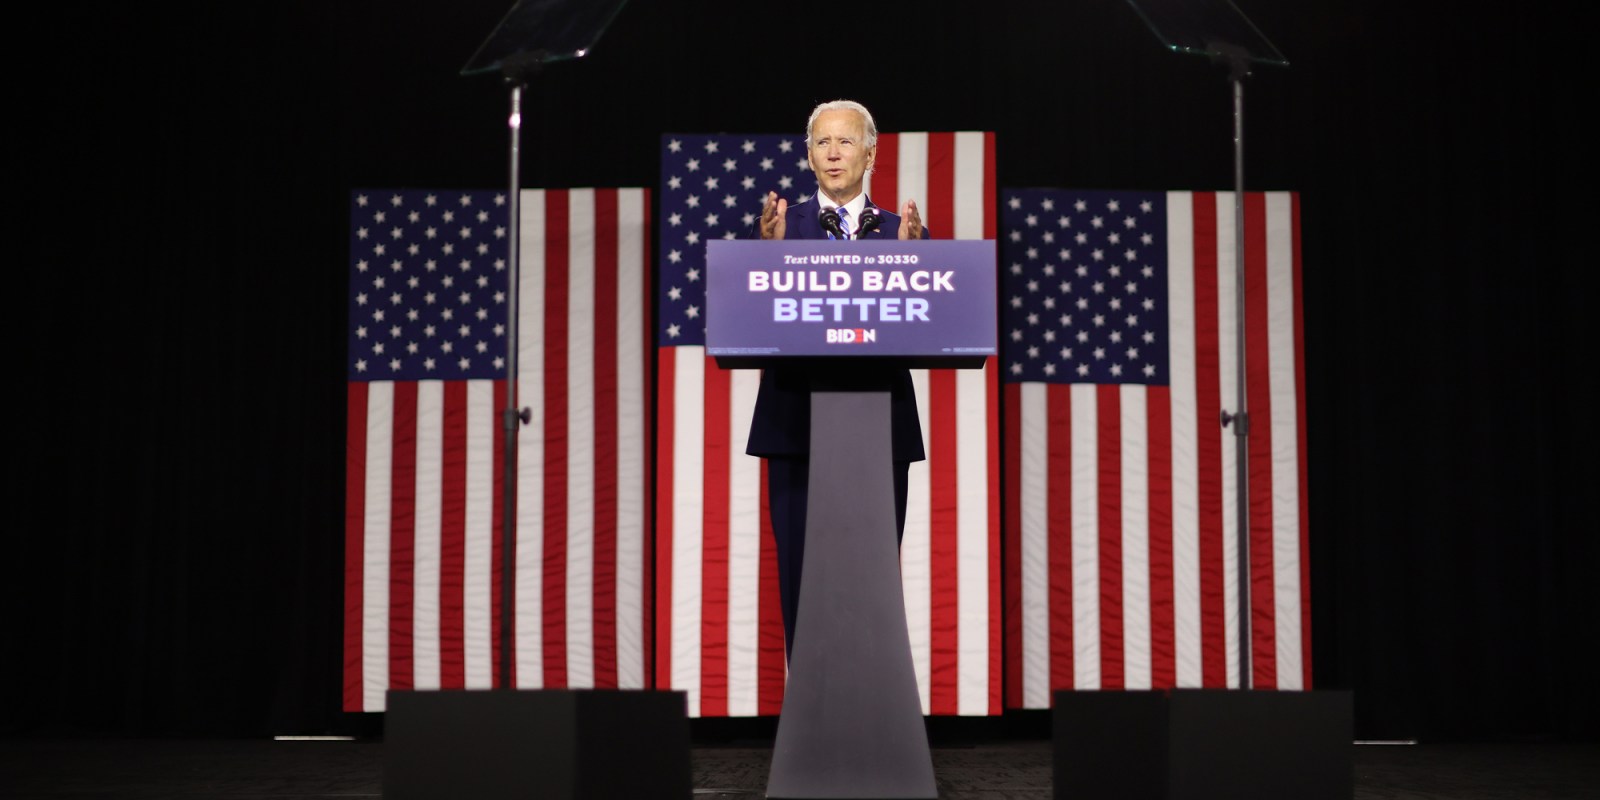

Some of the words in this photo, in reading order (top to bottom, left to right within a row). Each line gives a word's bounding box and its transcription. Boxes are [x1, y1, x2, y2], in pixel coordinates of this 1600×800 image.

[784, 255, 808, 265] Text
[811, 255, 861, 264] UNITED
[864, 256, 875, 265] to
[877, 255, 919, 264] 30330
[748, 270, 851, 292] BUILD
[862, 270, 955, 292] BACK
[773, 297, 930, 322] BETTER
[826, 328, 876, 343] BIDEN
